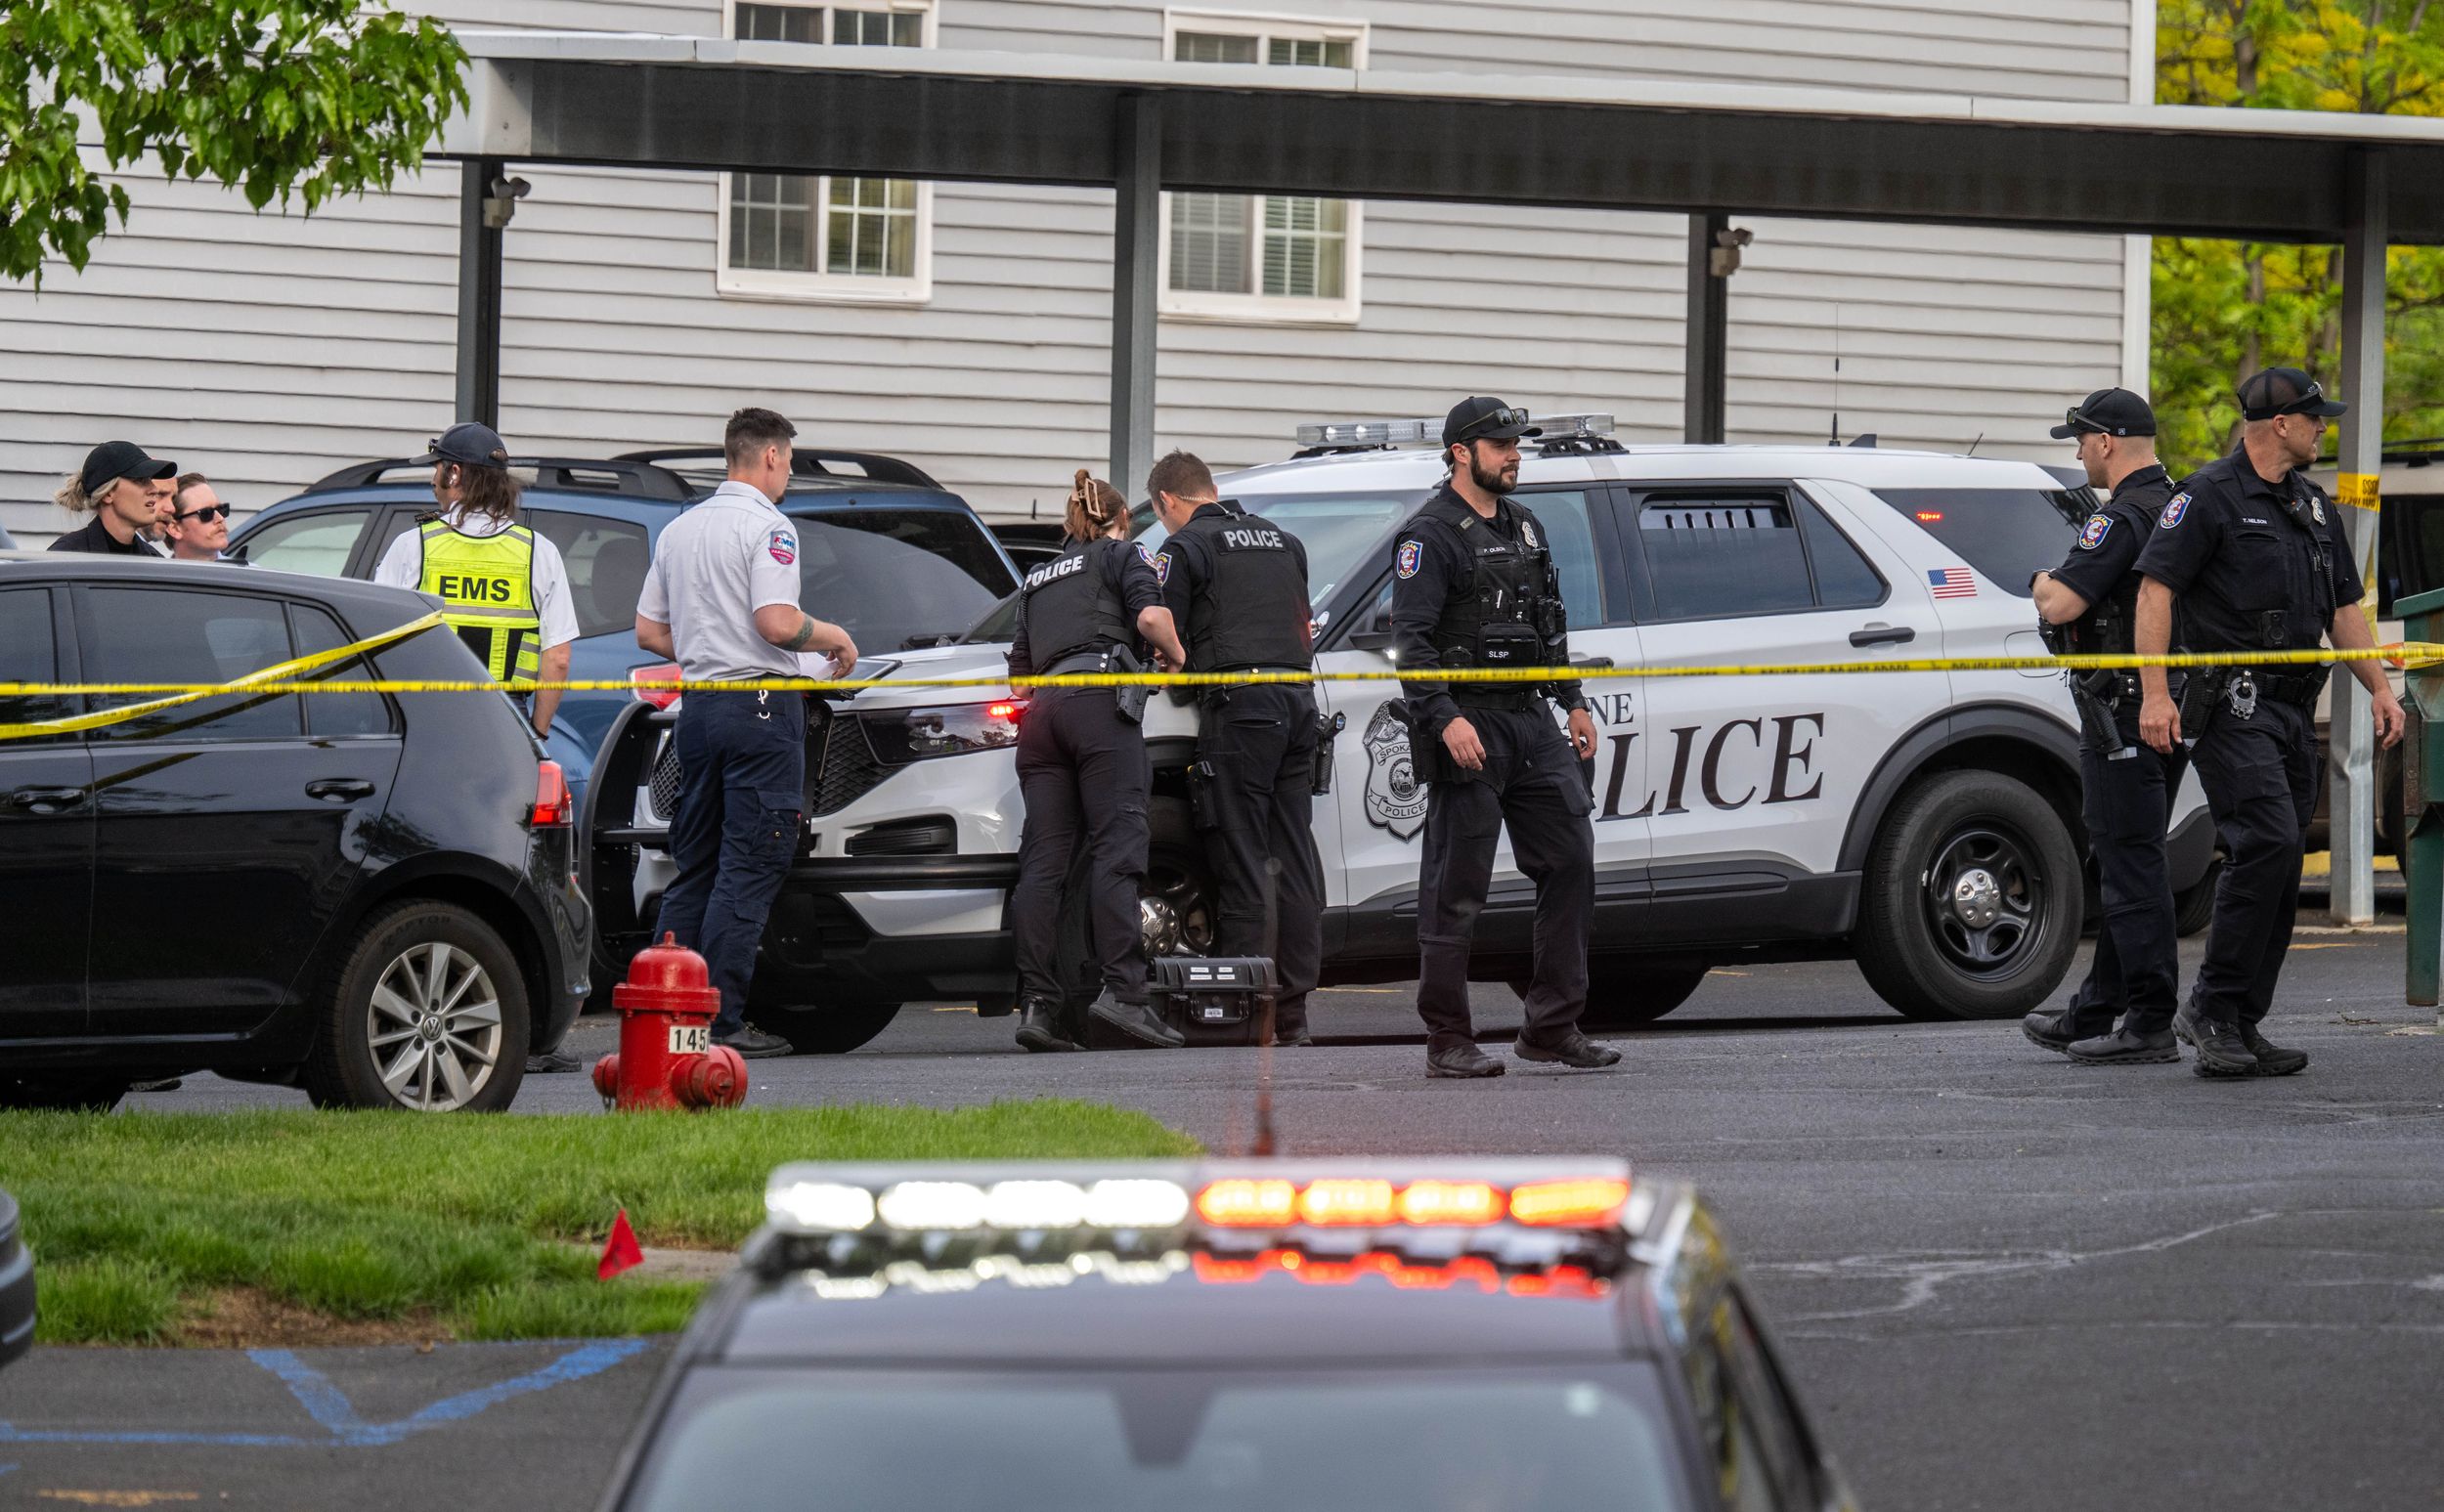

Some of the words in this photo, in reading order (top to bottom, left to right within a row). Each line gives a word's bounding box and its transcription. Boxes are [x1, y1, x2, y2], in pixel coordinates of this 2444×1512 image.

[1224, 529, 1284, 547] POLICE
[1024, 555, 1084, 591] POLICE
[439, 576, 510, 602] EMS
[1488, 650, 1509, 659] SLSP
[1379, 744, 1411, 759] SPOK
[1591, 713, 1824, 822] LICE
[1384, 802, 1426, 817] POLICE
[675, 1029, 706, 1051] 145
